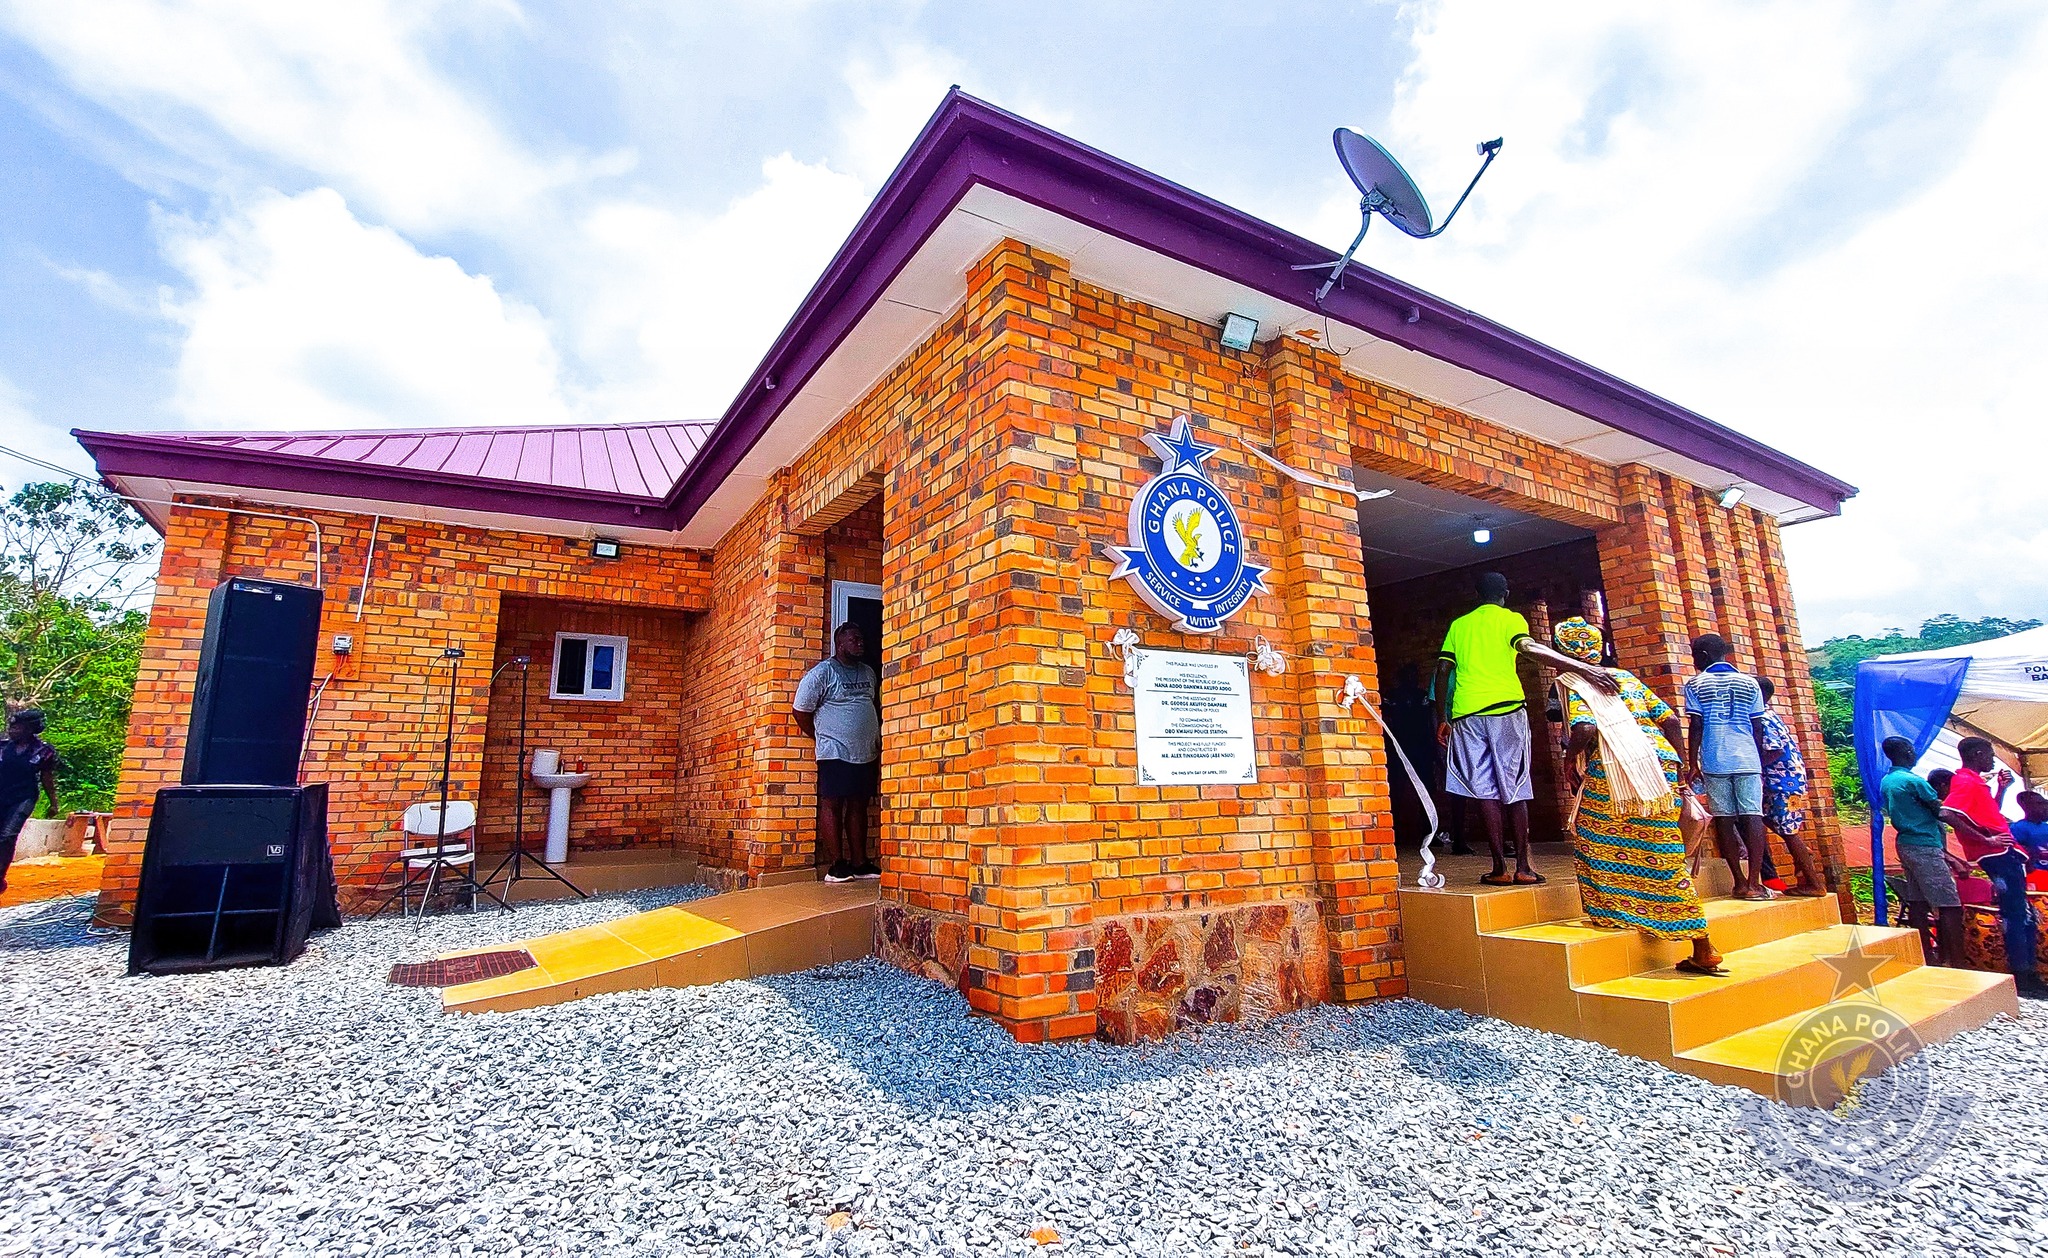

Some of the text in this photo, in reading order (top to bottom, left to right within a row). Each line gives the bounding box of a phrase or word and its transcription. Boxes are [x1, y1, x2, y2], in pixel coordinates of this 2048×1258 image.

[1148, 482, 1235, 555] GHANA POLICE
[1145, 571, 1250, 627] SERVICE WITH INTEGRITY
[1716, 689, 1735, 721] 3
